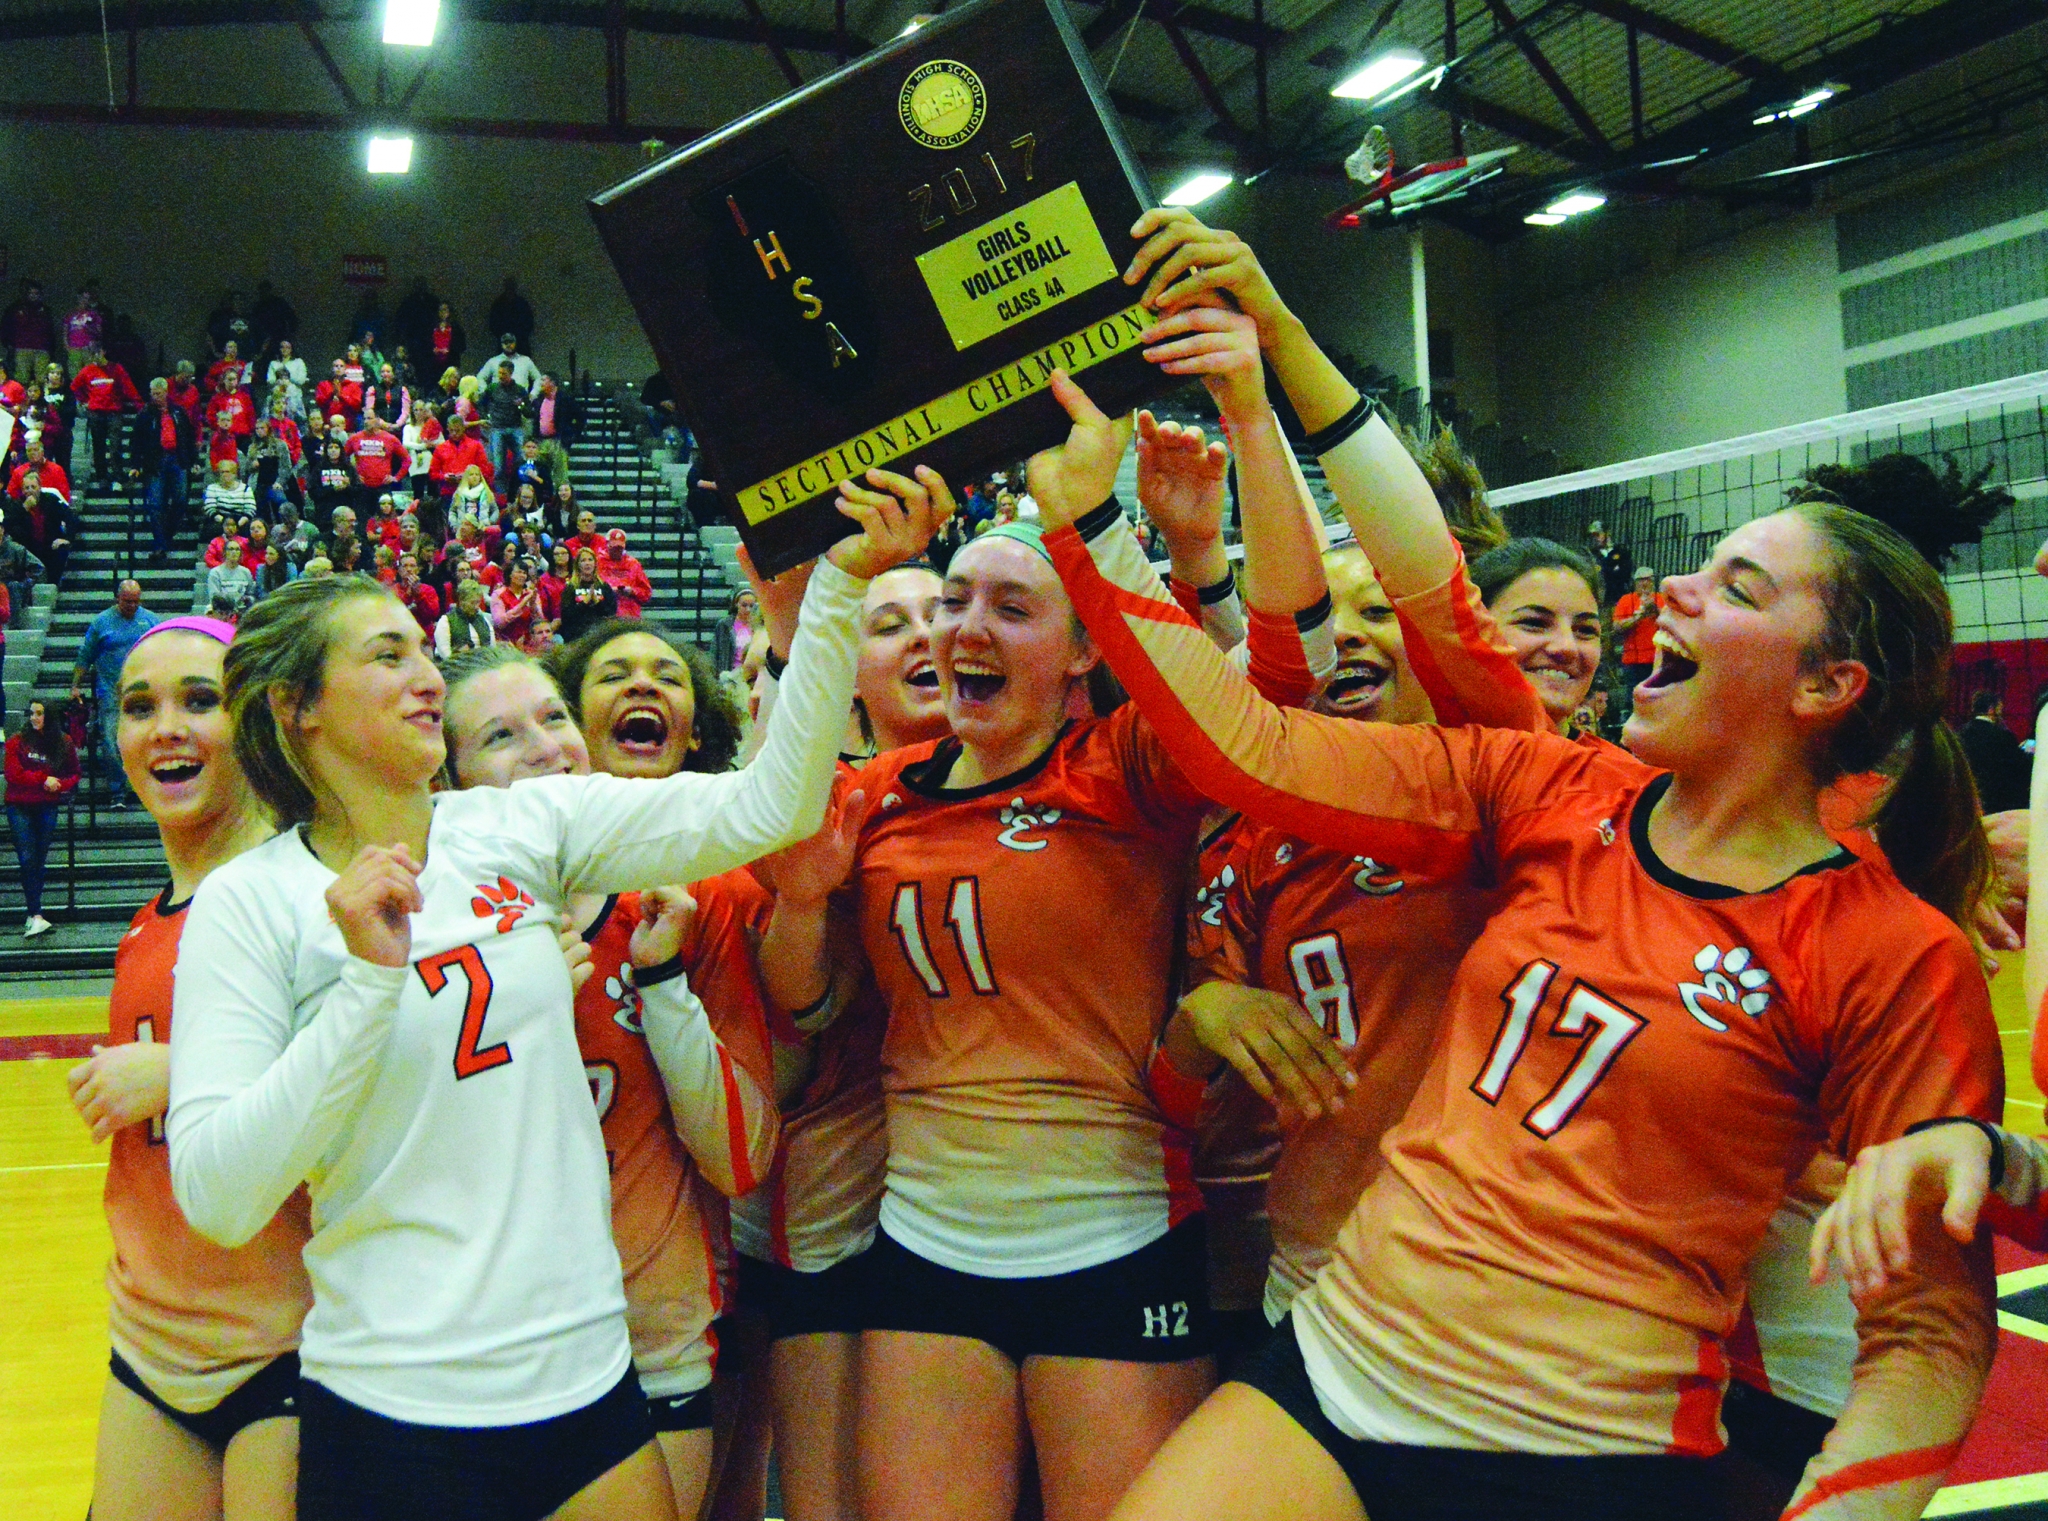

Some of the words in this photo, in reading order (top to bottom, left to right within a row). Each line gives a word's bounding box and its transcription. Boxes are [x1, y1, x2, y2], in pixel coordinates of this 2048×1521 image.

[902, 83, 917, 131] ILLINOIS
[914, 64, 942, 82] HIGH
[947, 64, 982, 99] SCHOOL
[918, 107, 982, 146] ASSOCIATION
[908, 132, 1036, 232] 2017
[961, 235, 1071, 301] VOLLEYBALL
[976, 220, 1031, 262] GIRLS
[996, 287, 1042, 321] CLASS
[1045, 276, 1066, 299] 4A
[757, 408, 942, 513] SECTIONAL
[967, 309, 1156, 413] CHAMPION
[888, 875, 1000, 998] 11
[413, 943, 513, 1081] 2
[1286, 928, 1361, 1048] 8
[1469, 957, 1650, 1141] 17
[1142, 1301, 1189, 1338] H2
